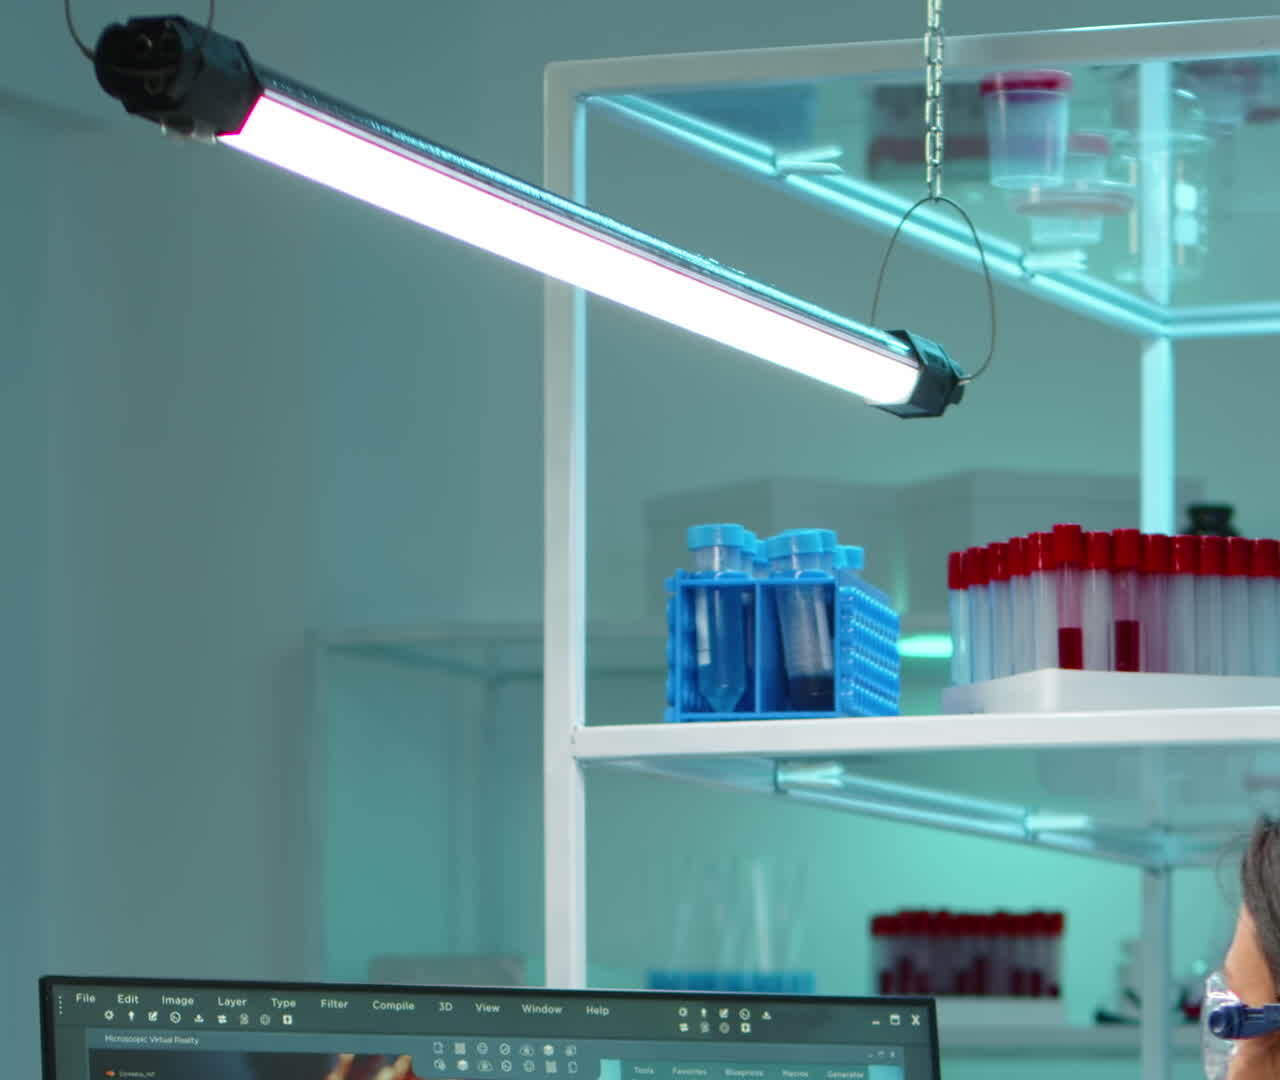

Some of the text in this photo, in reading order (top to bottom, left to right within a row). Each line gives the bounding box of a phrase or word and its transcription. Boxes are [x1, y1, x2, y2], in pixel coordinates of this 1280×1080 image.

[75, 992, 610, 1017] File Edit Image Layer Type Filter Compile 3D View Window Help
